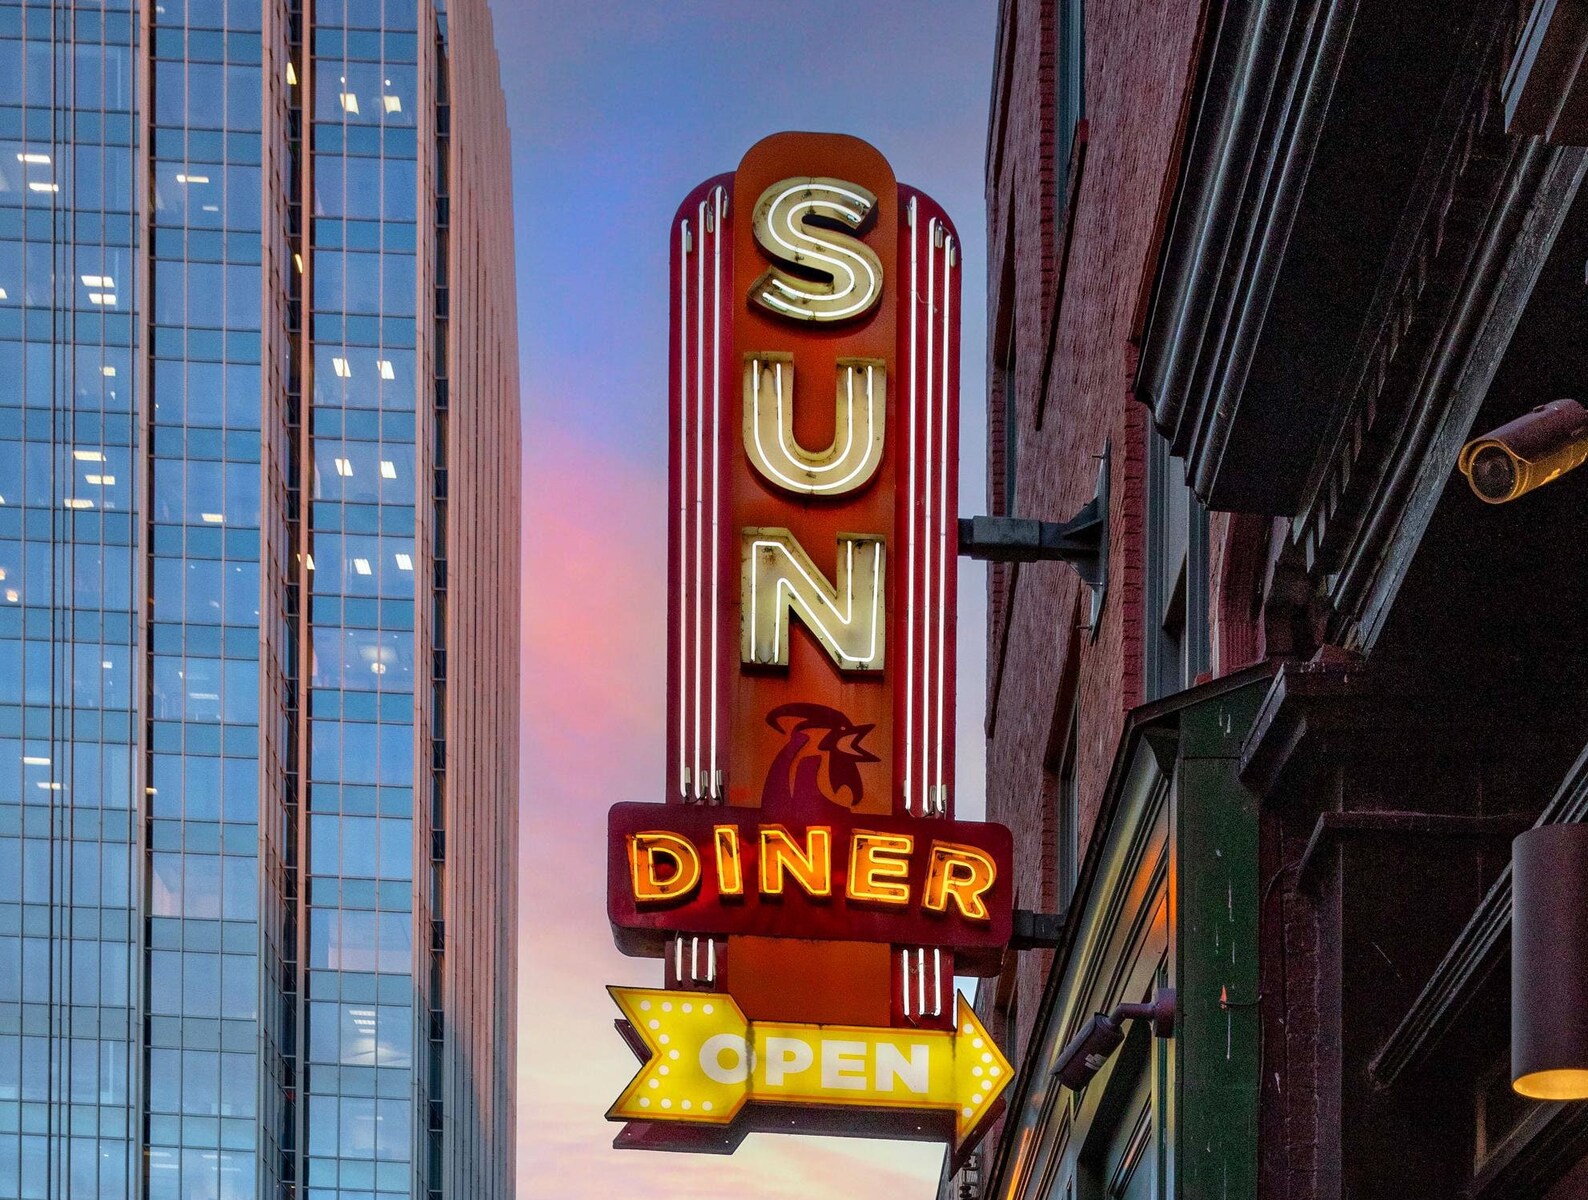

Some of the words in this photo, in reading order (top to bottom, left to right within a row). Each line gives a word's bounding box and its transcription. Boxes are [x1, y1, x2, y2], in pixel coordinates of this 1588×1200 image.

[741, 176, 886, 675] SUN
[626, 823, 997, 921] DINER
[699, 1033, 929, 1093] OPEN
